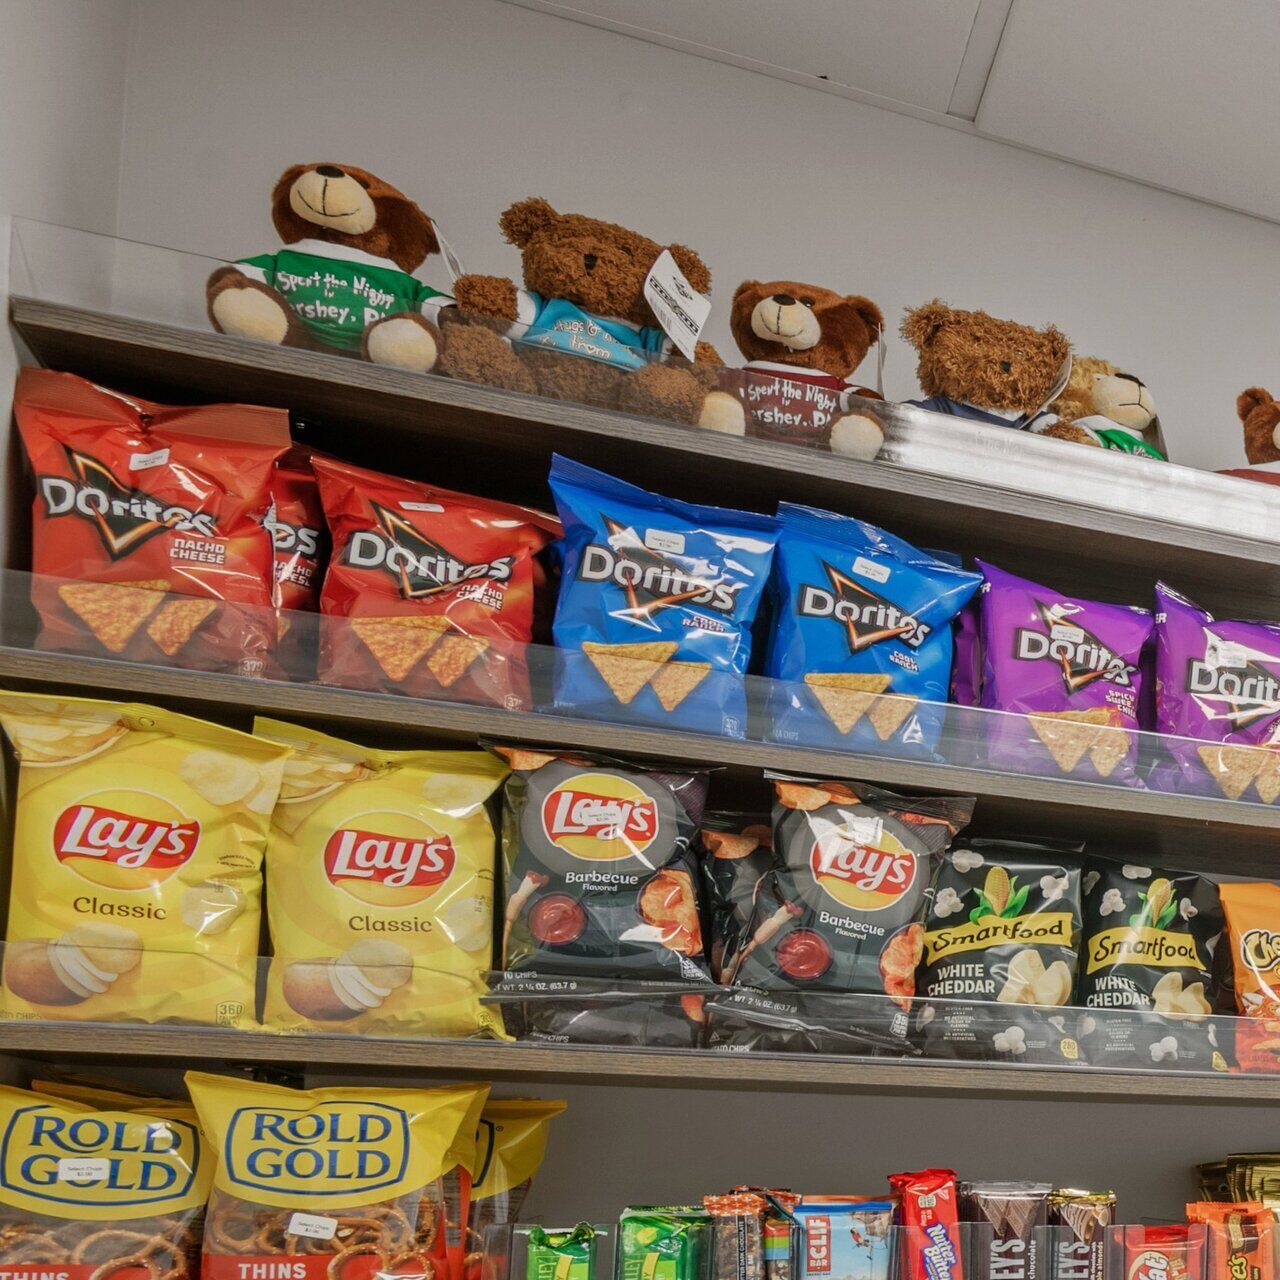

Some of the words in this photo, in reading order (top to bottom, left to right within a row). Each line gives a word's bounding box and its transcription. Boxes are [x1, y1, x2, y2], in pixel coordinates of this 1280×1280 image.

[41, 477, 215, 537] Doritos
[170, 549, 225, 565] CHEESE
[174, 538, 225, 554] NACHO
[350, 532, 512, 582] Doritos
[582, 546, 738, 614] Doritos
[802, 588, 931, 648] Doritos
[1019, 630, 1138, 686] Doritos
[61, 806, 194, 867] Lay's
[332, 830, 448, 887] Lay's
[565, 871, 639, 886] Barbecue
[73, 896, 168, 921] Classic
[819, 910, 886, 937] Barbecue
[349, 916, 433, 933] Classic
[932, 920, 1063, 953] Smartfood
[1094, 934, 1197, 963] Smartfood
[937, 963, 984, 981] WHITE
[928, 979, 996, 998] CHEDDAR
[1086, 991, 1151, 1008] CHEDDAR
[28, 1115, 183, 1154] ROLD
[251, 1112, 393, 1145] ROLD
[245, 1147, 392, 1180] GOLD
[809, 1219, 828, 1258] CLIF
[238, 1262, 307, 1280] THINS
[809, 1259, 829, 1267] BAR
